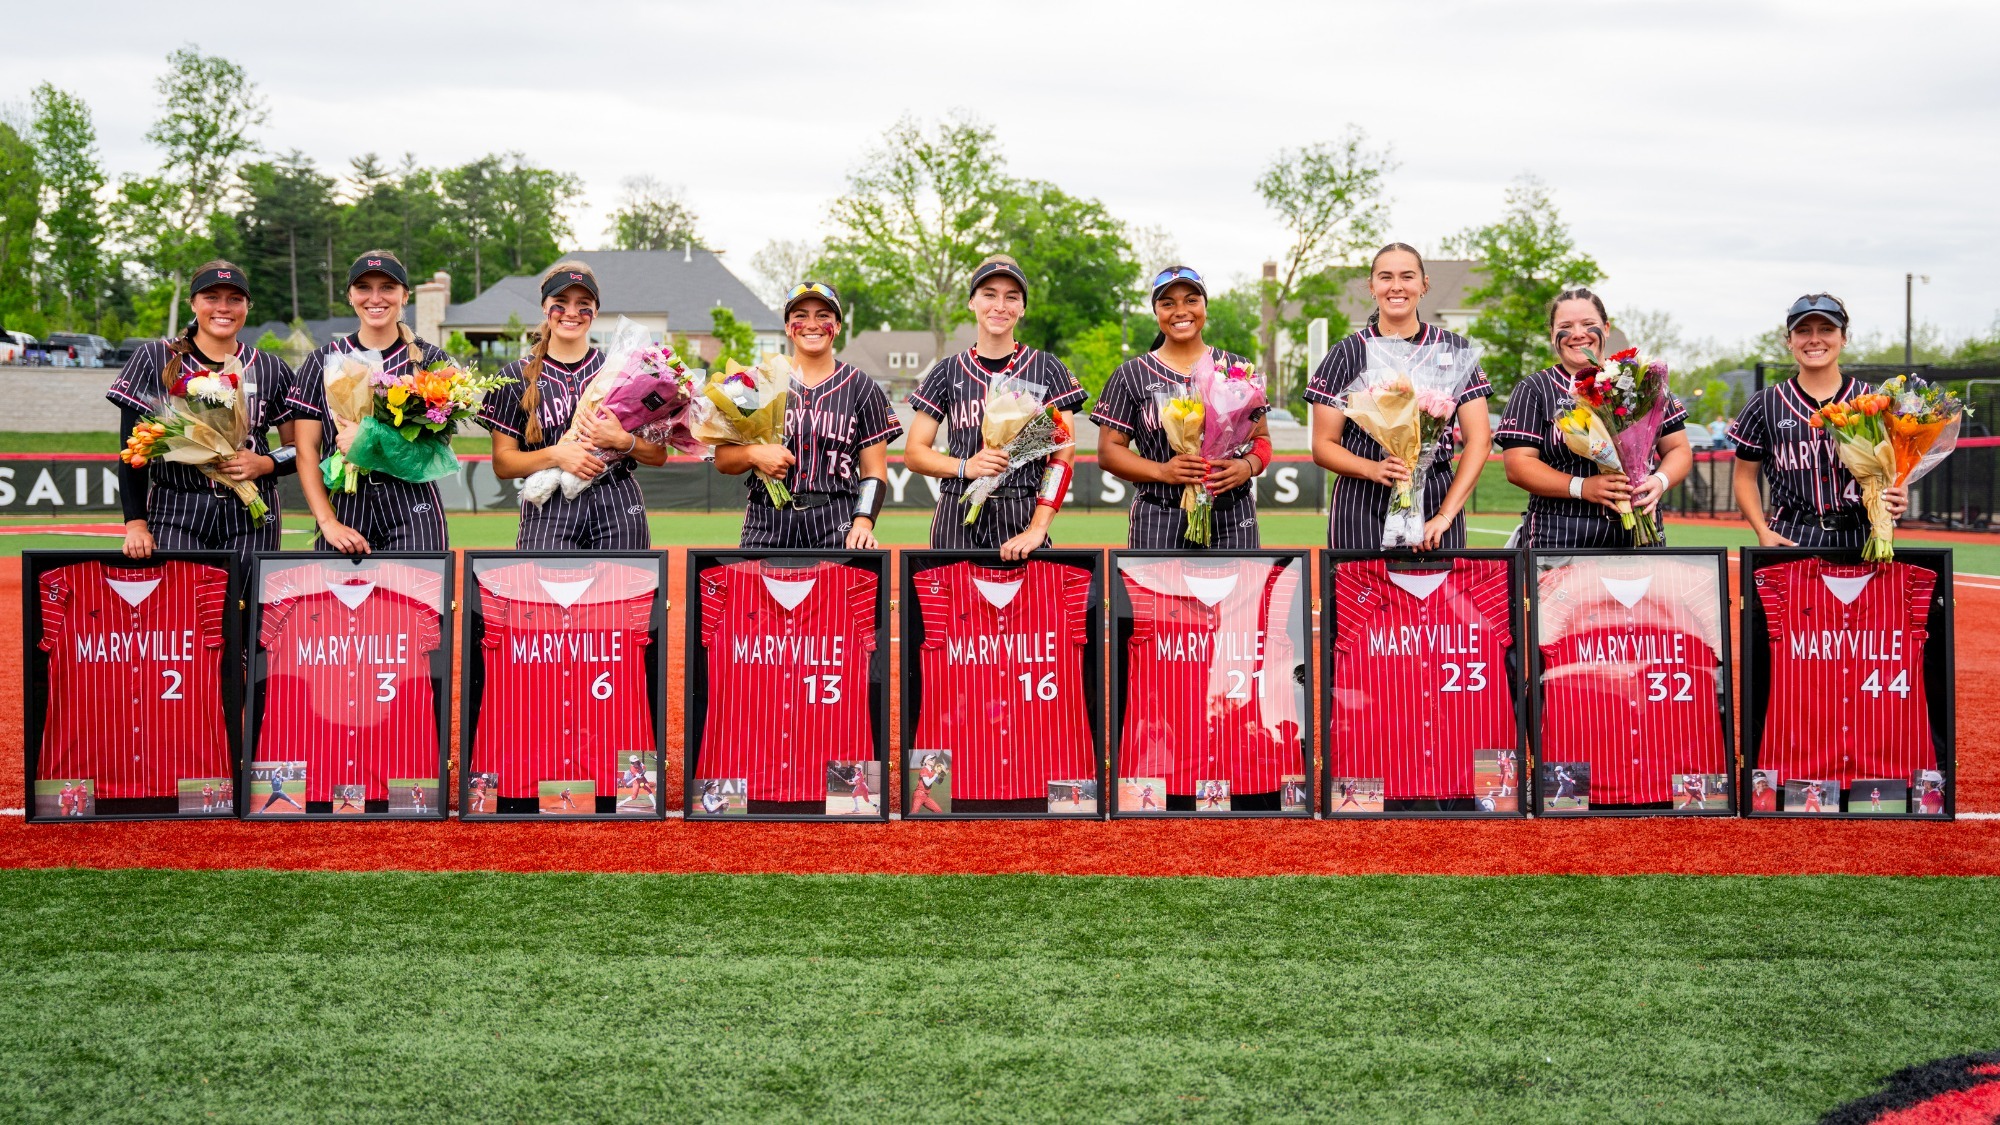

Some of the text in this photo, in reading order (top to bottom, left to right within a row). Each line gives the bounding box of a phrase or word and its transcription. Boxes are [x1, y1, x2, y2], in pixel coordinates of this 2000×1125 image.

[826, 450, 852, 479] 13
[76, 630, 194, 663] MARYVILLE
[298, 633, 407, 666] MARYVILLE
[512, 631, 622, 664] MARYVILLE
[734, 634, 843, 667] MARYVILLE
[948, 632, 1056, 665] MARYVILLE
[1156, 630, 1264, 662] MARYVILLE
[1369, 623, 1479, 657] MARYVILLE
[1577, 633, 1684, 666] MARYVILLE
[1790, 630, 1903, 660] MARYVILLE
[160, 669, 183, 700] 2
[376, 672, 397, 703] 3
[591, 671, 613, 700] 6
[802, 674, 843, 705] 13
[1018, 671, 1058, 702] 16
[1225, 669, 1266, 699] 21
[1440, 662, 1487, 692] 23
[1647, 672, 1693, 702] 32
[1860, 669, 1911, 699] 44
